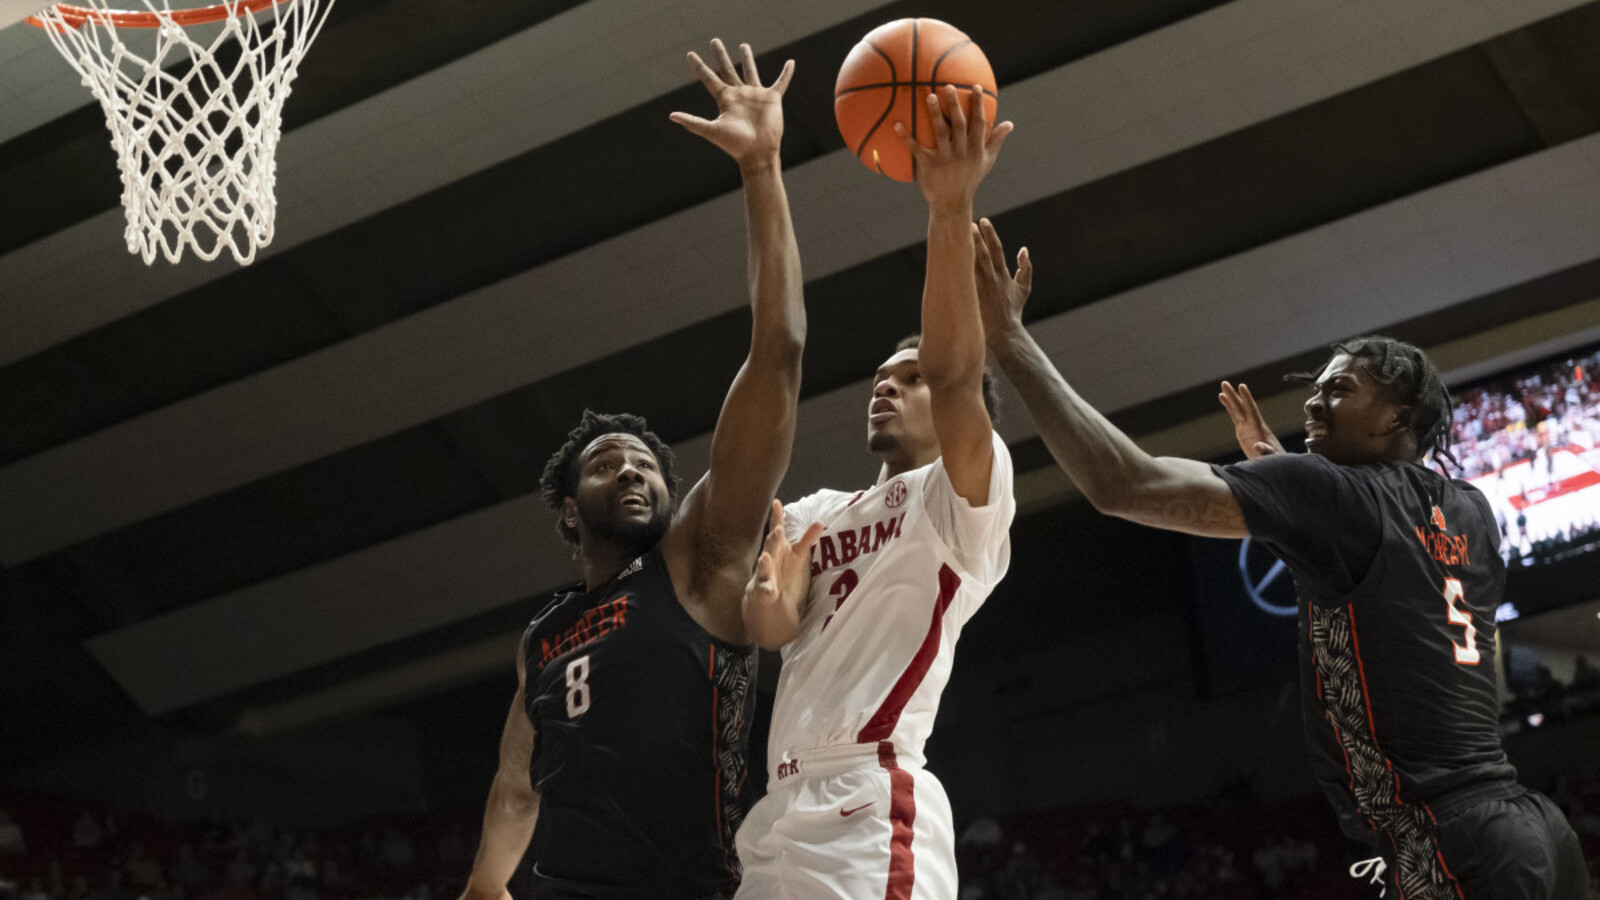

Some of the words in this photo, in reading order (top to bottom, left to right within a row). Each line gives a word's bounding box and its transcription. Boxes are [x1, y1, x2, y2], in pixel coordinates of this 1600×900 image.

[886, 481, 907, 508] SEC
[1442, 577, 1480, 666] 5
[565, 655, 591, 719] 8
[777, 758, 799, 780] RTR
